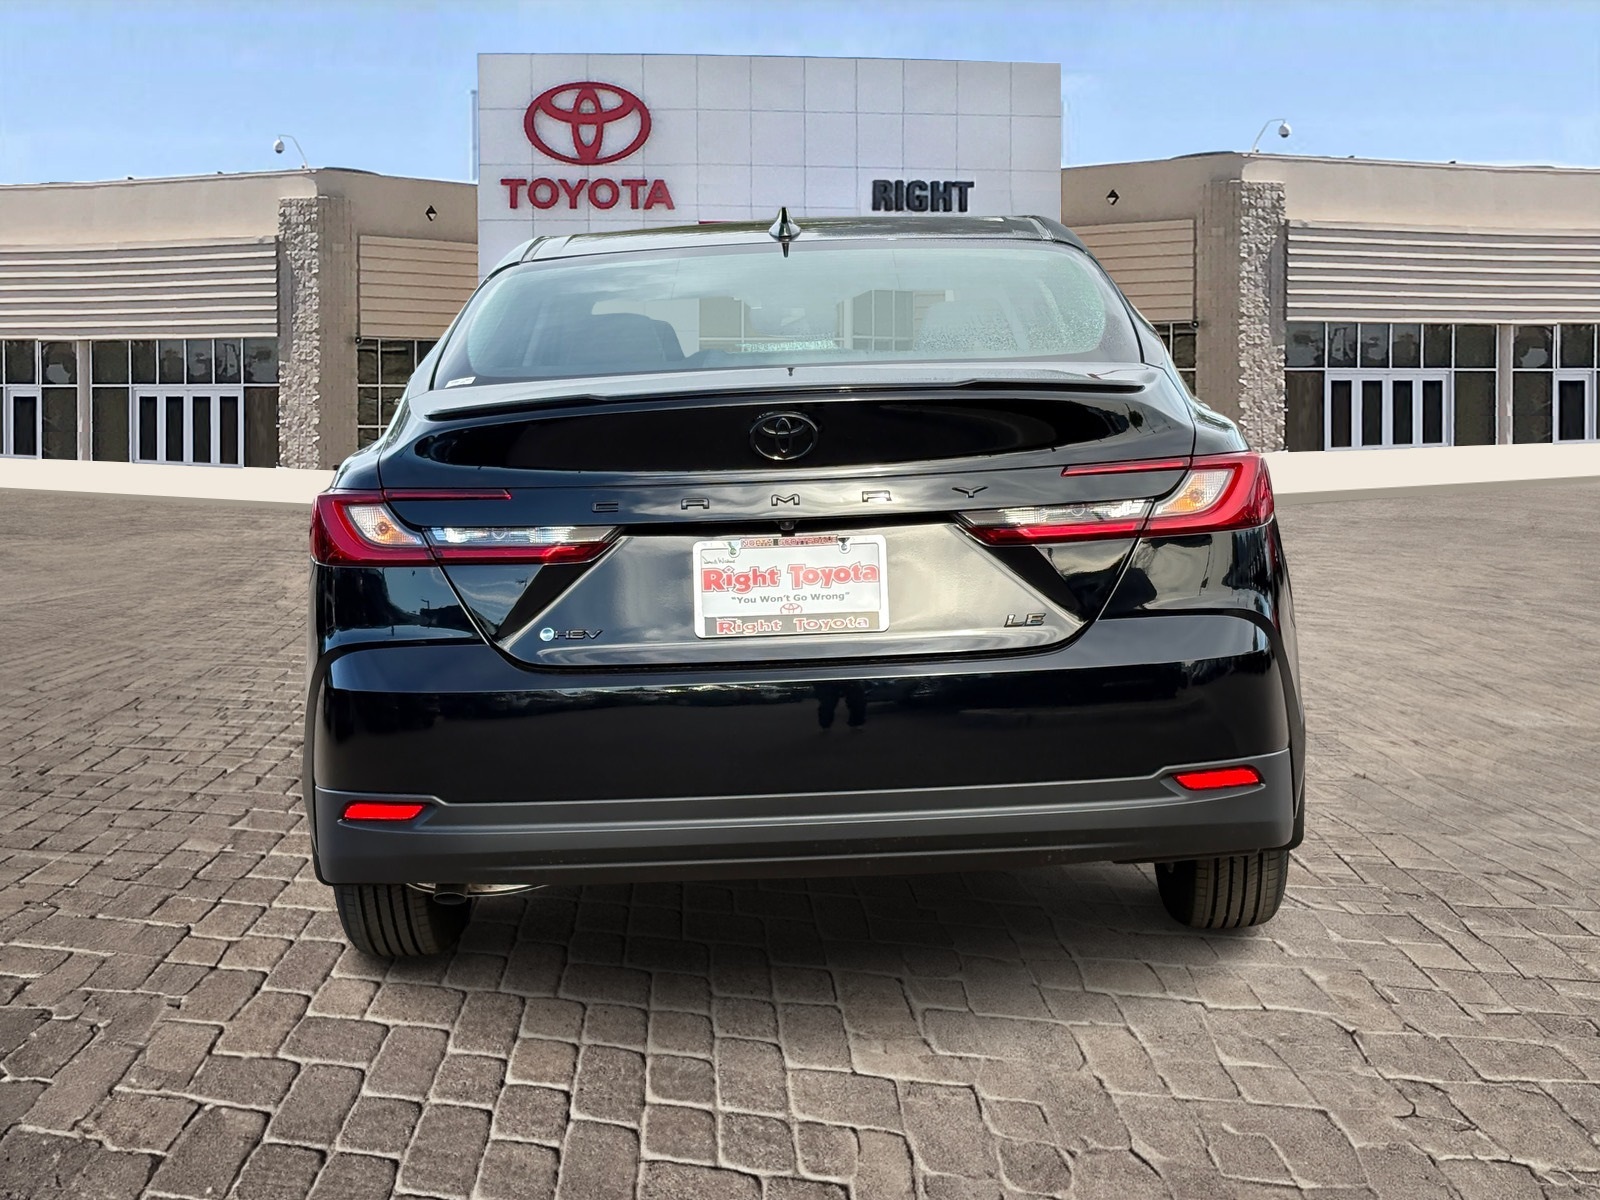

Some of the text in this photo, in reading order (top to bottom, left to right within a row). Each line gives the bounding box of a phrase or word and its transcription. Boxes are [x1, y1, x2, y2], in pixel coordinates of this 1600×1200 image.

[500, 179, 676, 210] TOYOTA
[872, 180, 975, 213] RIGHT
[591, 484, 989, 513] CAMRY
[701, 561, 880, 594] Right Toyota
[793, 593, 808, 602] Go
[716, 616, 870, 635] Right Toyota
[1004, 613, 1047, 628] LE
[555, 628, 602, 640] HEV
